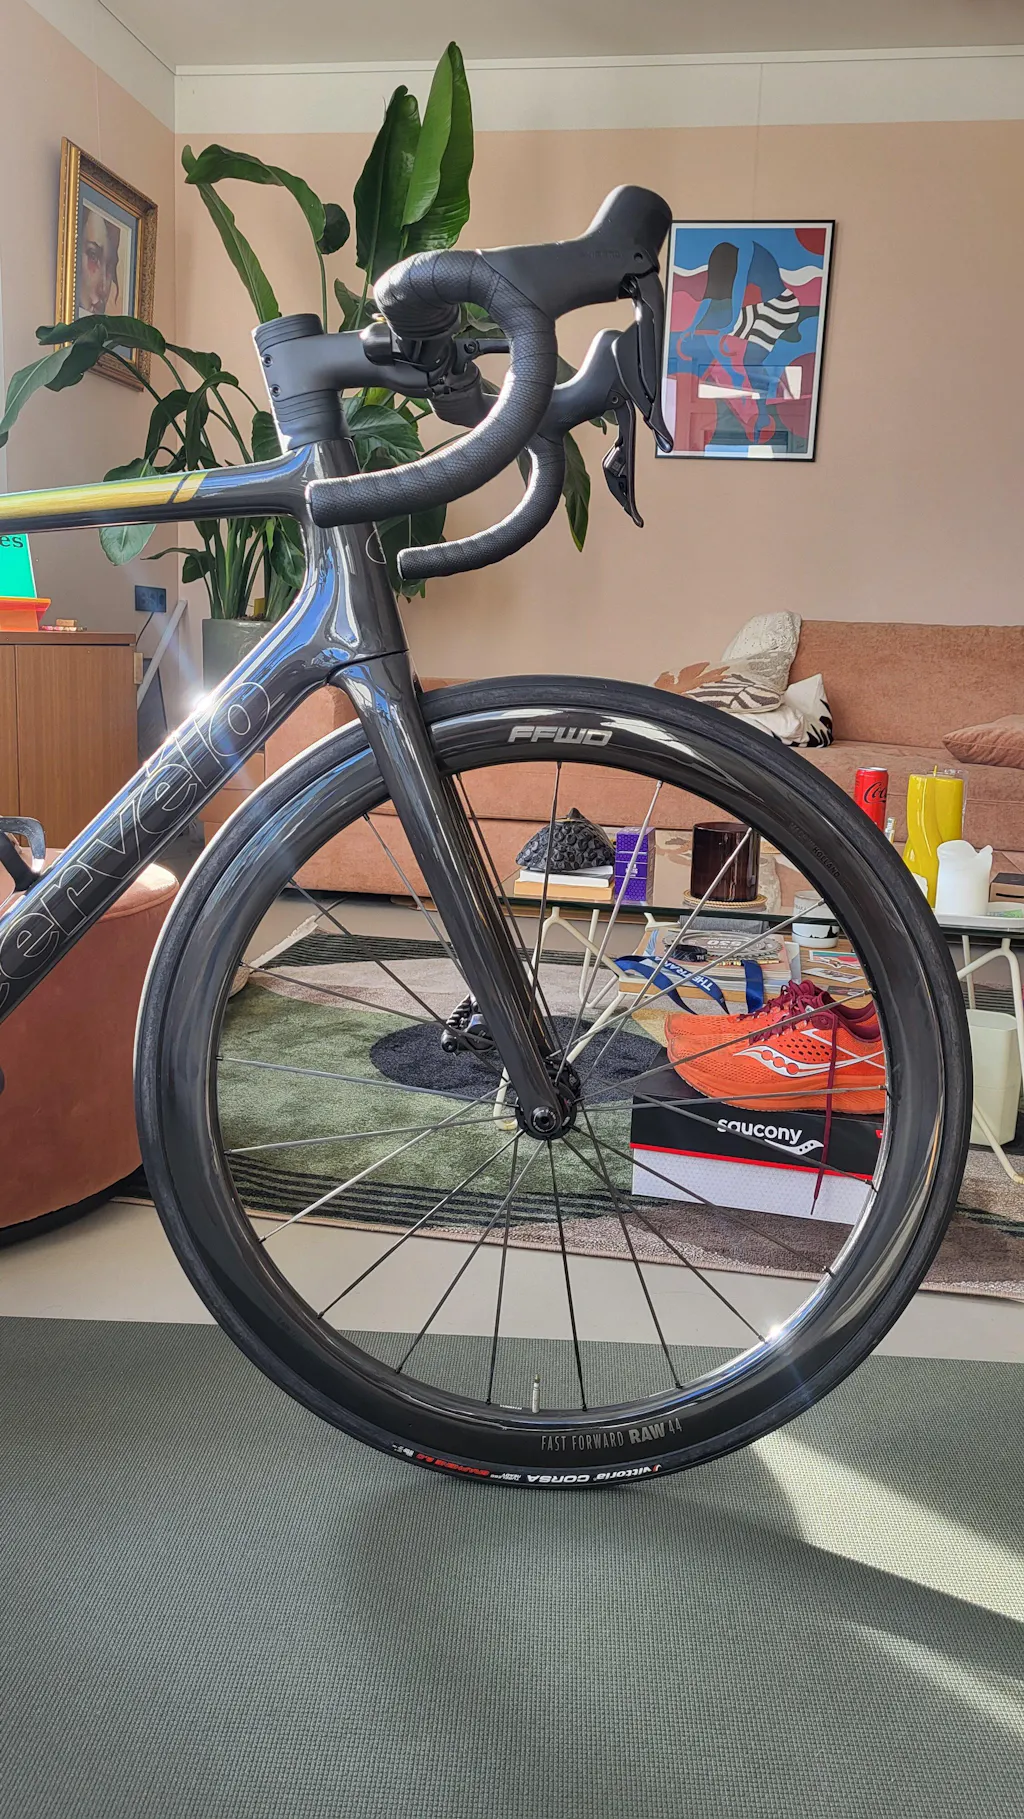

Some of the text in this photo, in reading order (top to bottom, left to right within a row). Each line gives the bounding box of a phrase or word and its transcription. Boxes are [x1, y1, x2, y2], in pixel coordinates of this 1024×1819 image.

[0, 681, 270, 1008] ervélo
[813, 847, 841, 878] HOLLAND
[716, 1118, 803, 1145] saucony
[541, 1417, 683, 1452] FAST FORWARD RAW 44
[527, 1474, 590, 1484] CORSA
